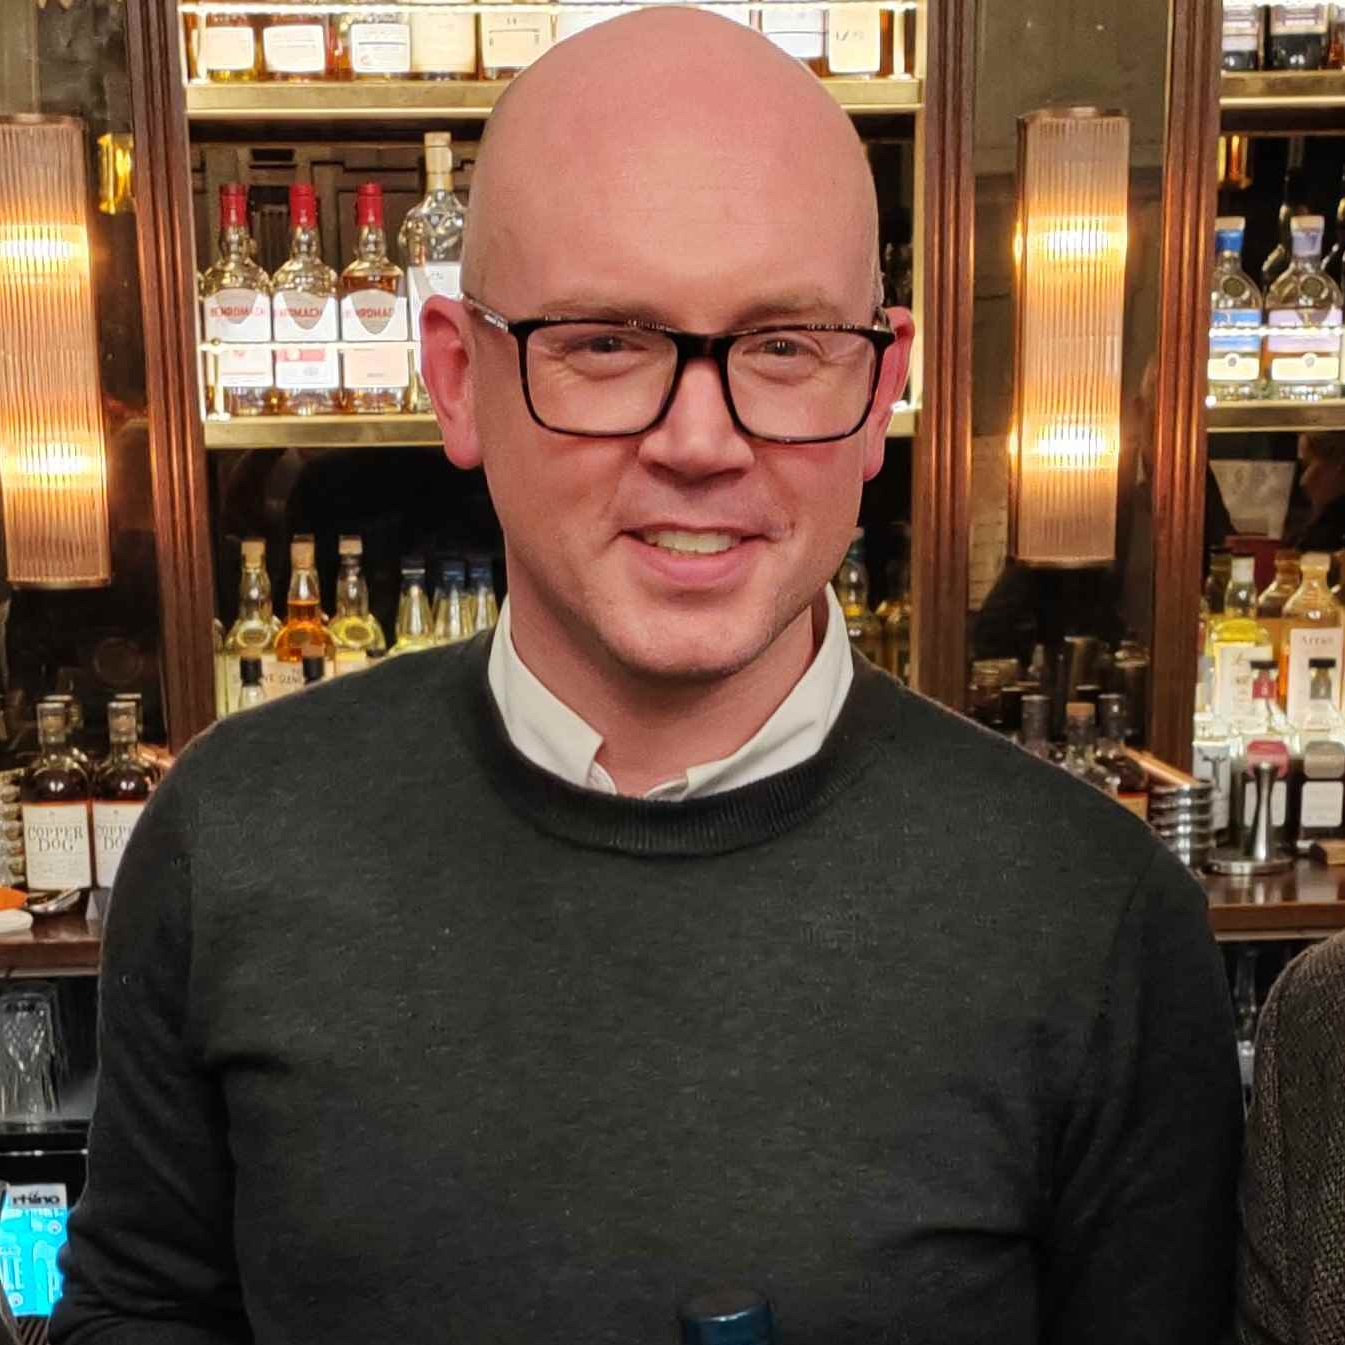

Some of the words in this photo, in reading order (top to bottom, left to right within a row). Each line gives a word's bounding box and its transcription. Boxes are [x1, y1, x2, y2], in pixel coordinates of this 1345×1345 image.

[28, 825, 83, 841] COPPER
[39, 838, 73, 852] DOG
[104, 837, 125, 850] DO
[13, 1191, 60, 1204] rhino
